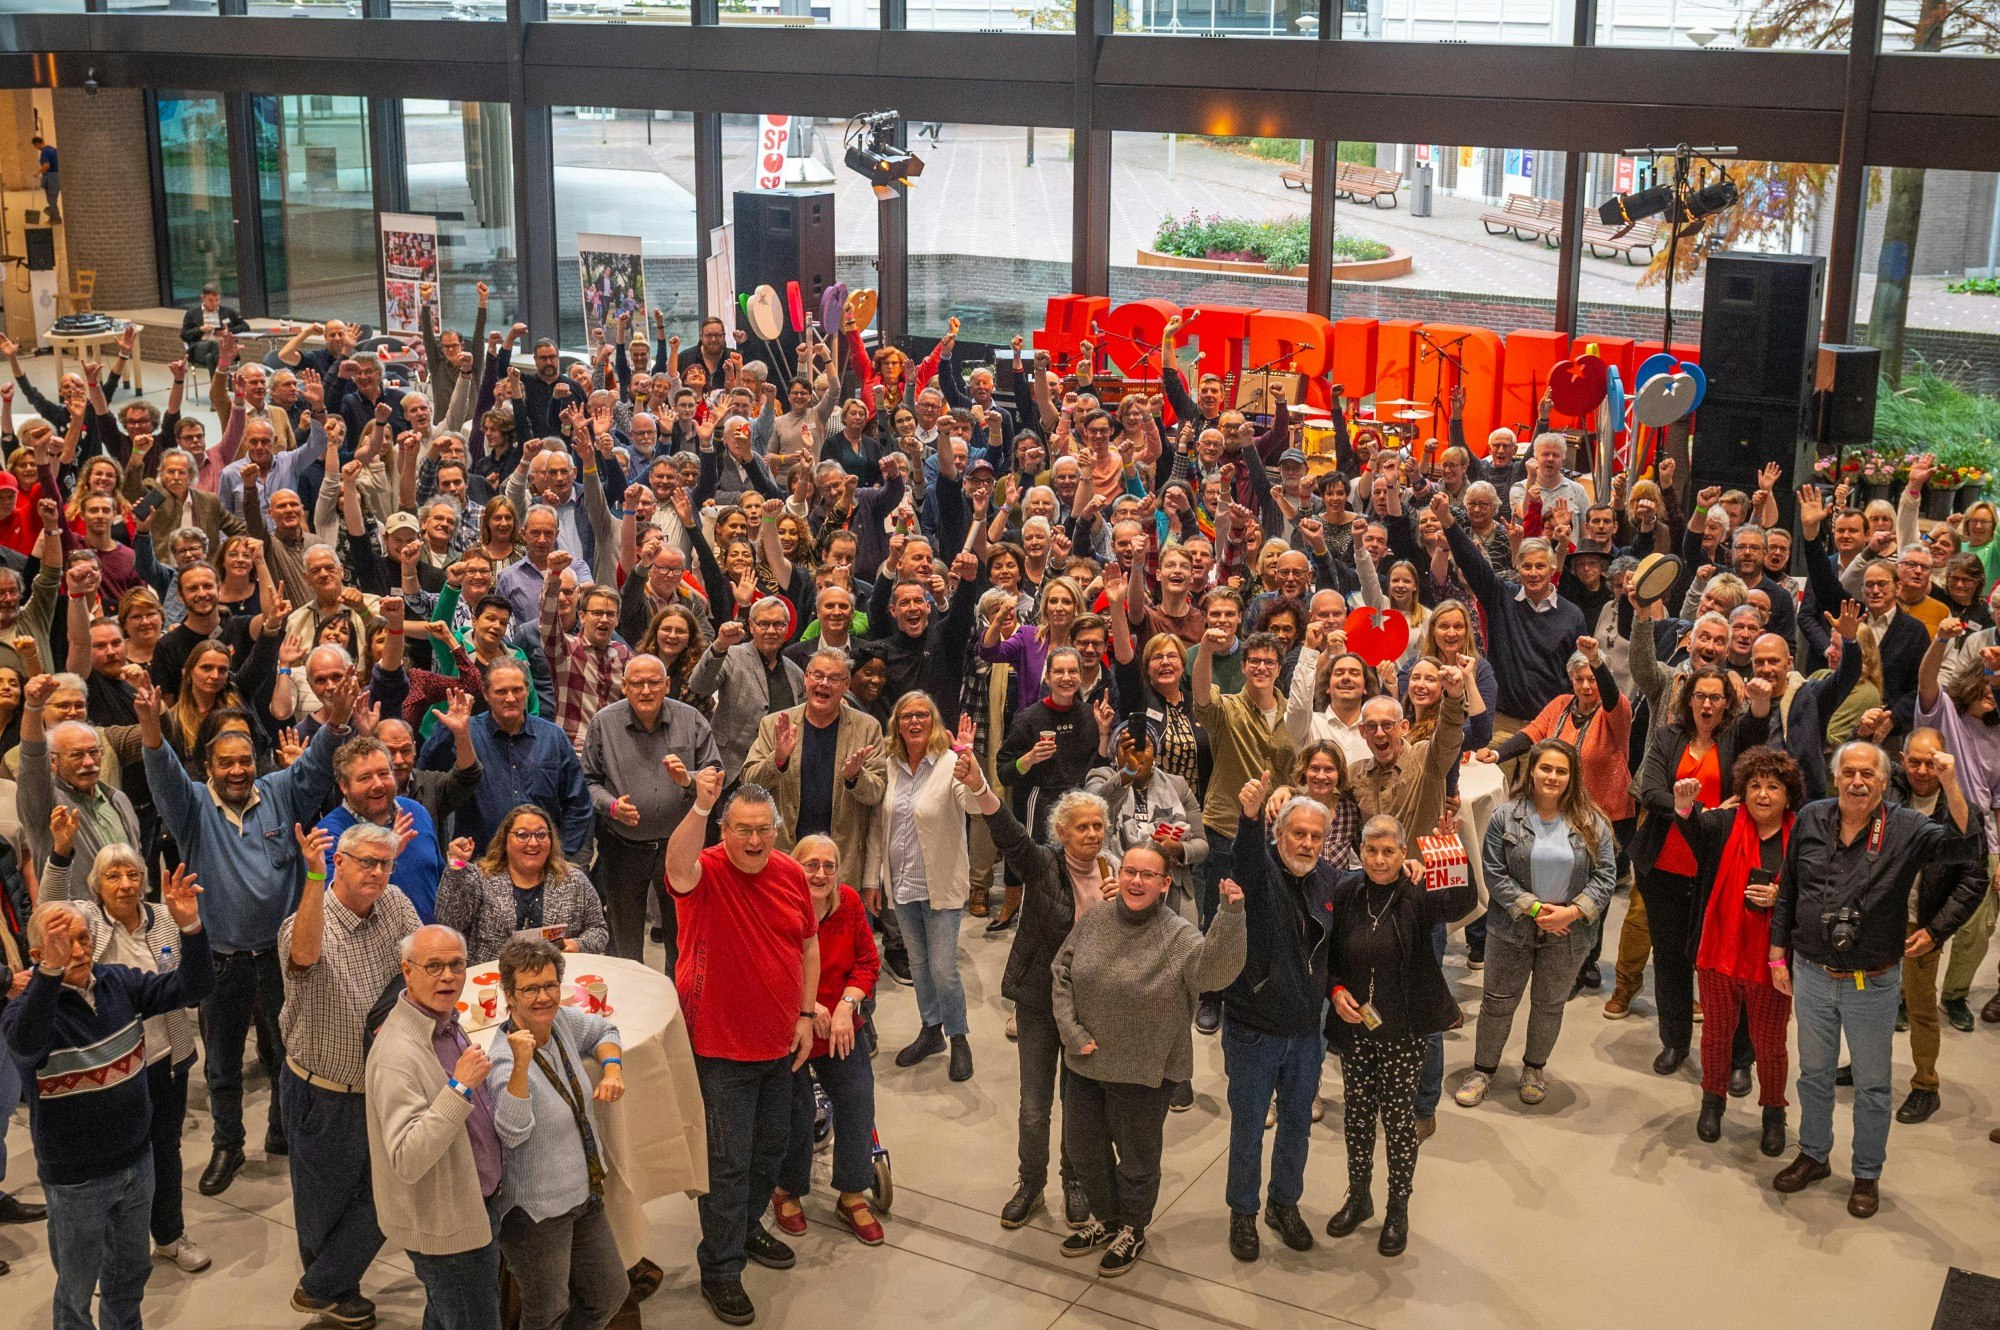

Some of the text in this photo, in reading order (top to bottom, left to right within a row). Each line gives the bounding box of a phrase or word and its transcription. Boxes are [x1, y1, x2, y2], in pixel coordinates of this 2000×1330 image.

[764, 129, 788, 151] SP
[1873, 818, 1881, 832] EOS
[1417, 833, 1460, 851] KOM
[1423, 848, 1468, 869] BINN
[1426, 868, 1449, 889] EN
[697, 940, 707, 971] EAST
[693, 974, 704, 999] SIDE
